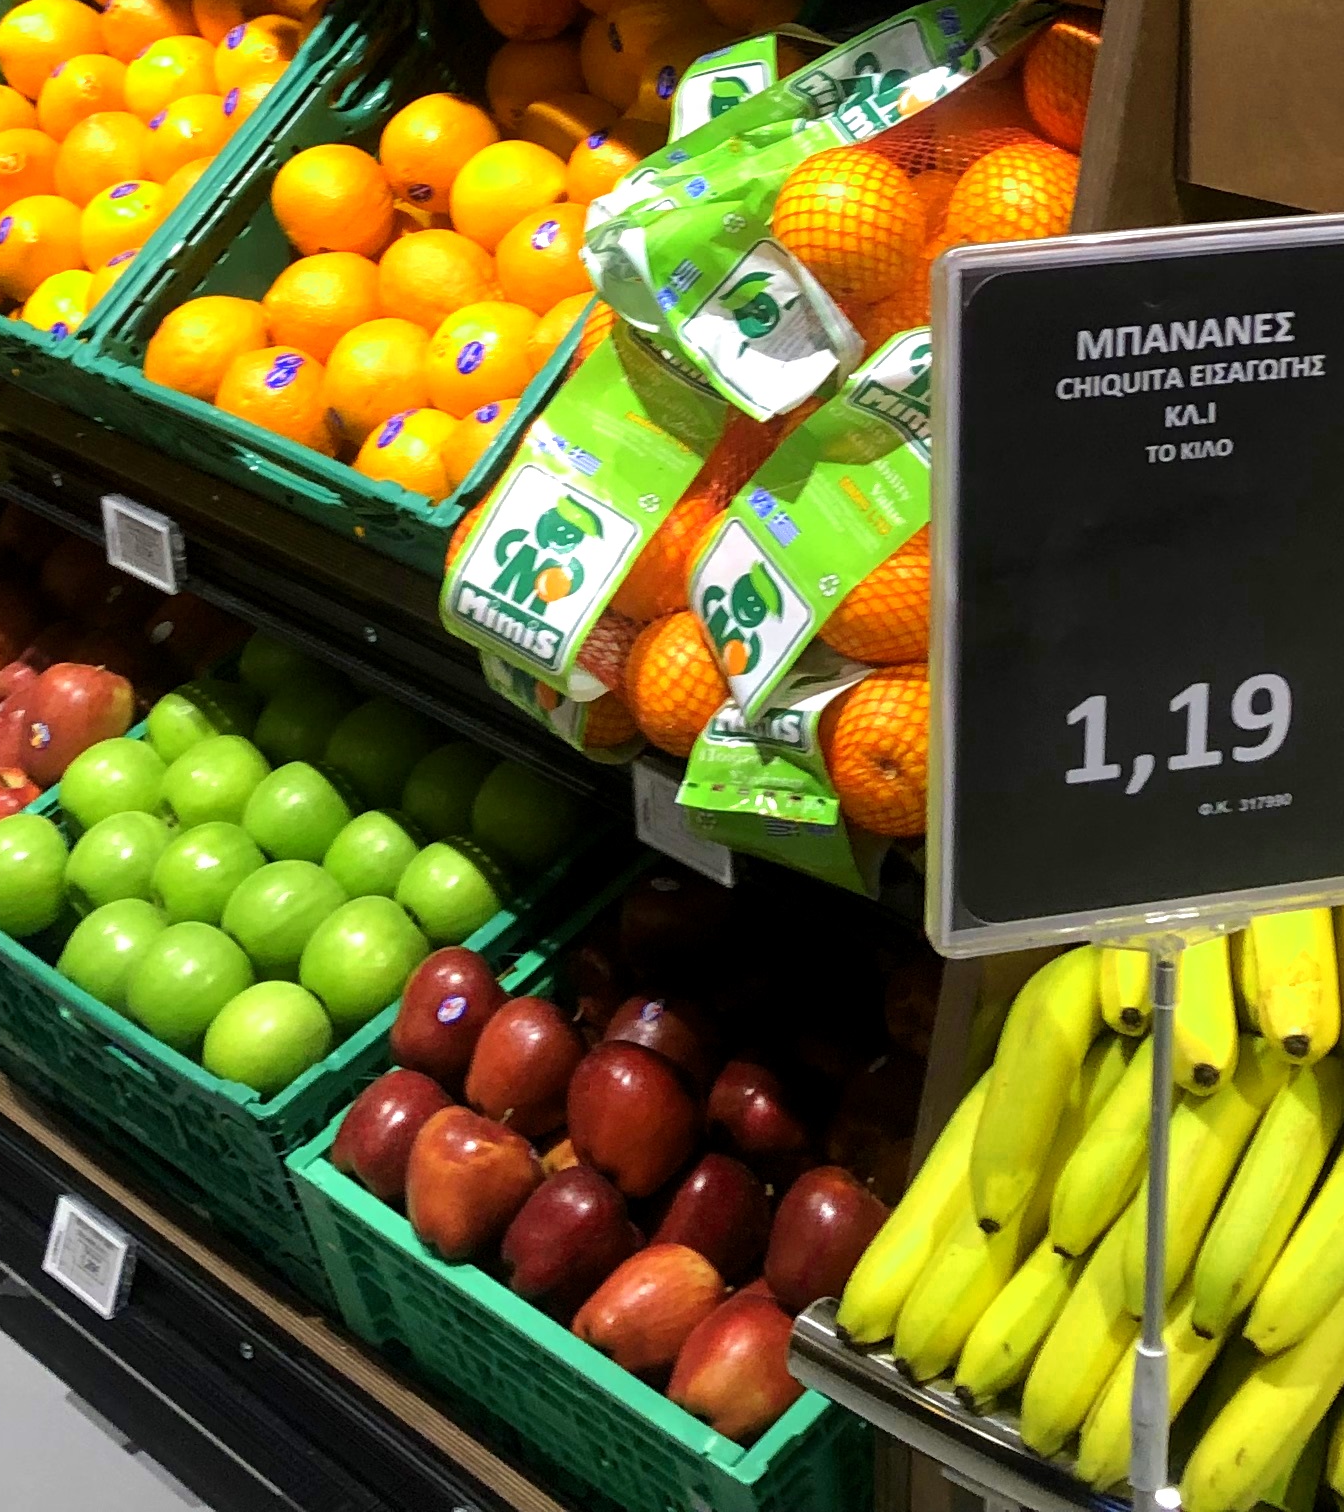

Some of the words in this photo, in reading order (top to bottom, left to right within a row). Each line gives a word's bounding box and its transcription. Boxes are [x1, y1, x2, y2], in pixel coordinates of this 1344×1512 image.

[1076, 311, 1296, 361] ΜΠΑΝΑΝΕΣ
[1056, 367, 1185, 400] CHIQUITA
[1189, 354, 1327, 387] ΕΙΣΑΓΩΓΗΣ
[1144, 444, 1176, 464] ΤΟ
[1180, 438, 1234, 460] ΚΙΛΟ
[1064, 672, 1294, 795] 1,19
